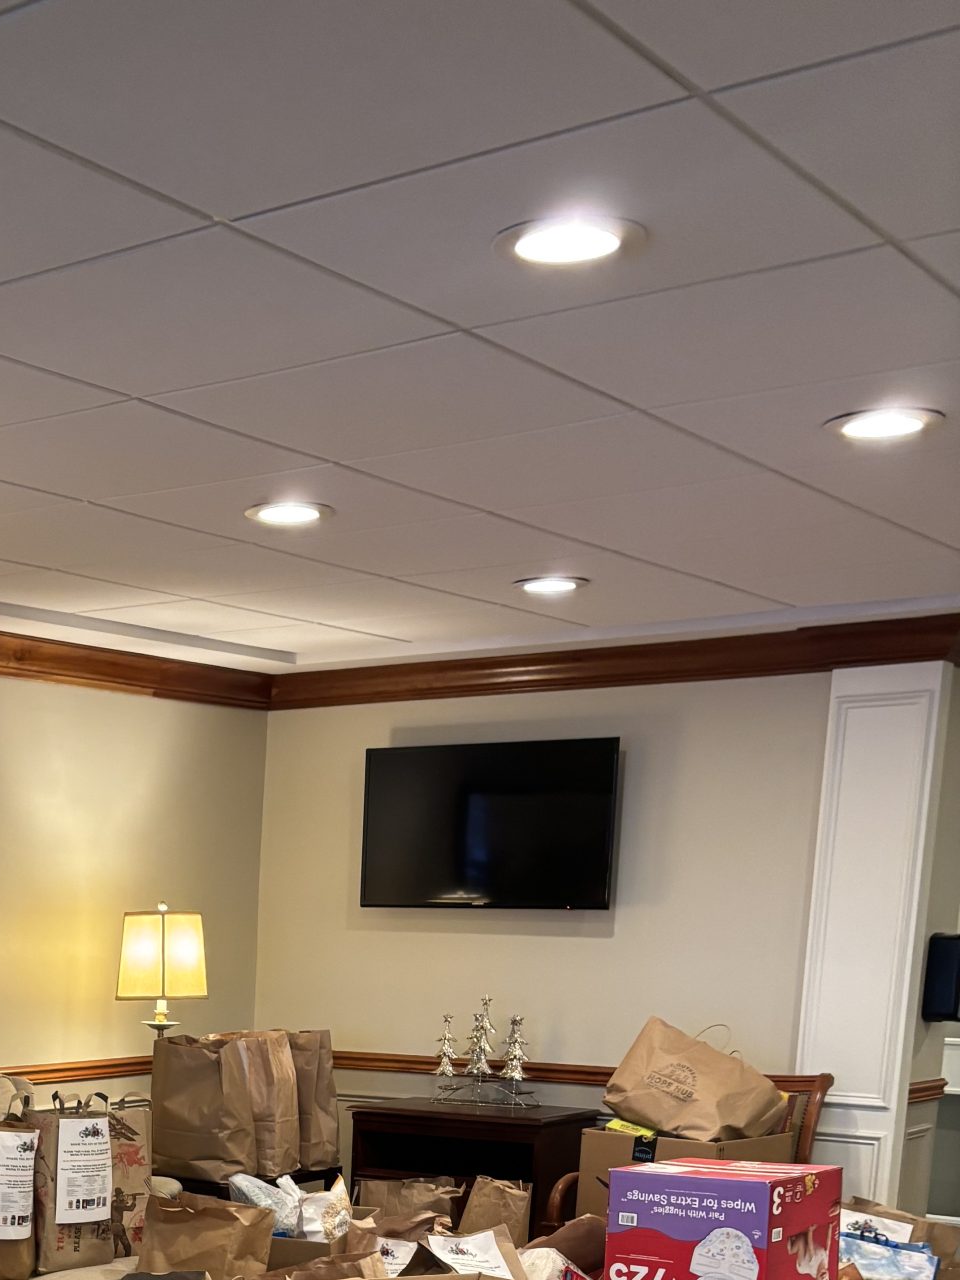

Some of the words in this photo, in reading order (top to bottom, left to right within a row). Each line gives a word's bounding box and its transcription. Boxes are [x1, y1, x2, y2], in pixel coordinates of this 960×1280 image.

[671, 1195, 699, 1209] Extra
[702, 1198, 718, 1211] for
[721, 1199, 755, 1213] Wipes
[773, 1186, 784, 1215] 3
[688, 1209, 707, 1219] With
[709, 1211, 725, 1220] Pair
